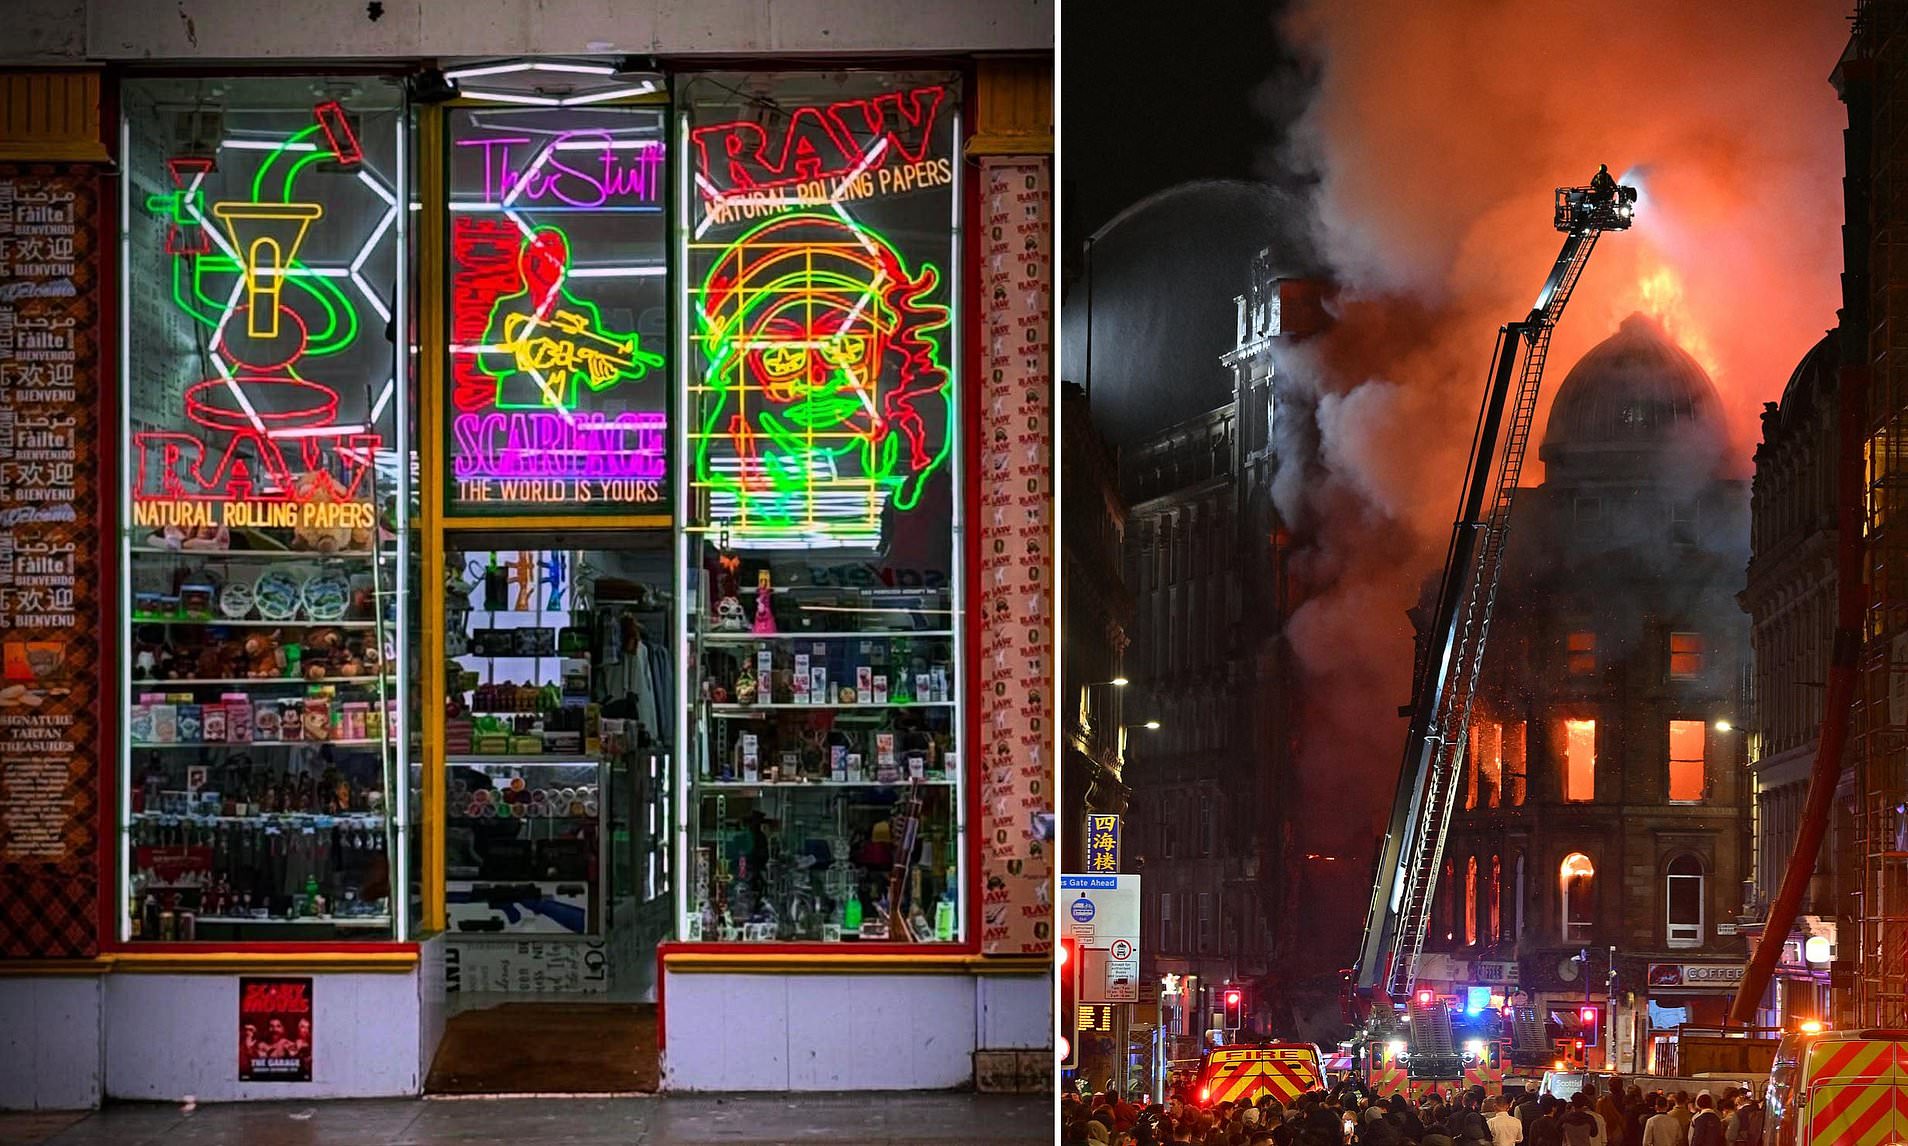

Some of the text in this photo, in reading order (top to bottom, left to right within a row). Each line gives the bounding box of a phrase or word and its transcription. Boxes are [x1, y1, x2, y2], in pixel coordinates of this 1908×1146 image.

[692, 86, 944, 197] RAW
[456, 129, 665, 207] The Stuff
[705, 158, 951, 225] NATURAL ROLLING PAPERS
[15, 237, 75, 261] 欢迎
[15, 363, 75, 387] 欢迎
[454, 413, 666, 476] SCARFACE
[15, 462, 75, 486] 欢迎
[134, 432, 382, 503] RAW
[458, 480, 659, 502] THE WORLD IS YOURS
[133, 501, 375, 528] NATURAL ROLLING PAPERS
[15, 588, 75, 612] 欢迎
[11, 728, 62, 738] TARTAN
[1093, 816, 1117, 871] 四海楼
[1069, 879, 1089, 887] Gate
[1090, 879, 1115, 887] Ahead
[1687, 967, 1743, 979] COFFEE
[1226, 1051, 1299, 1060] FIRE
